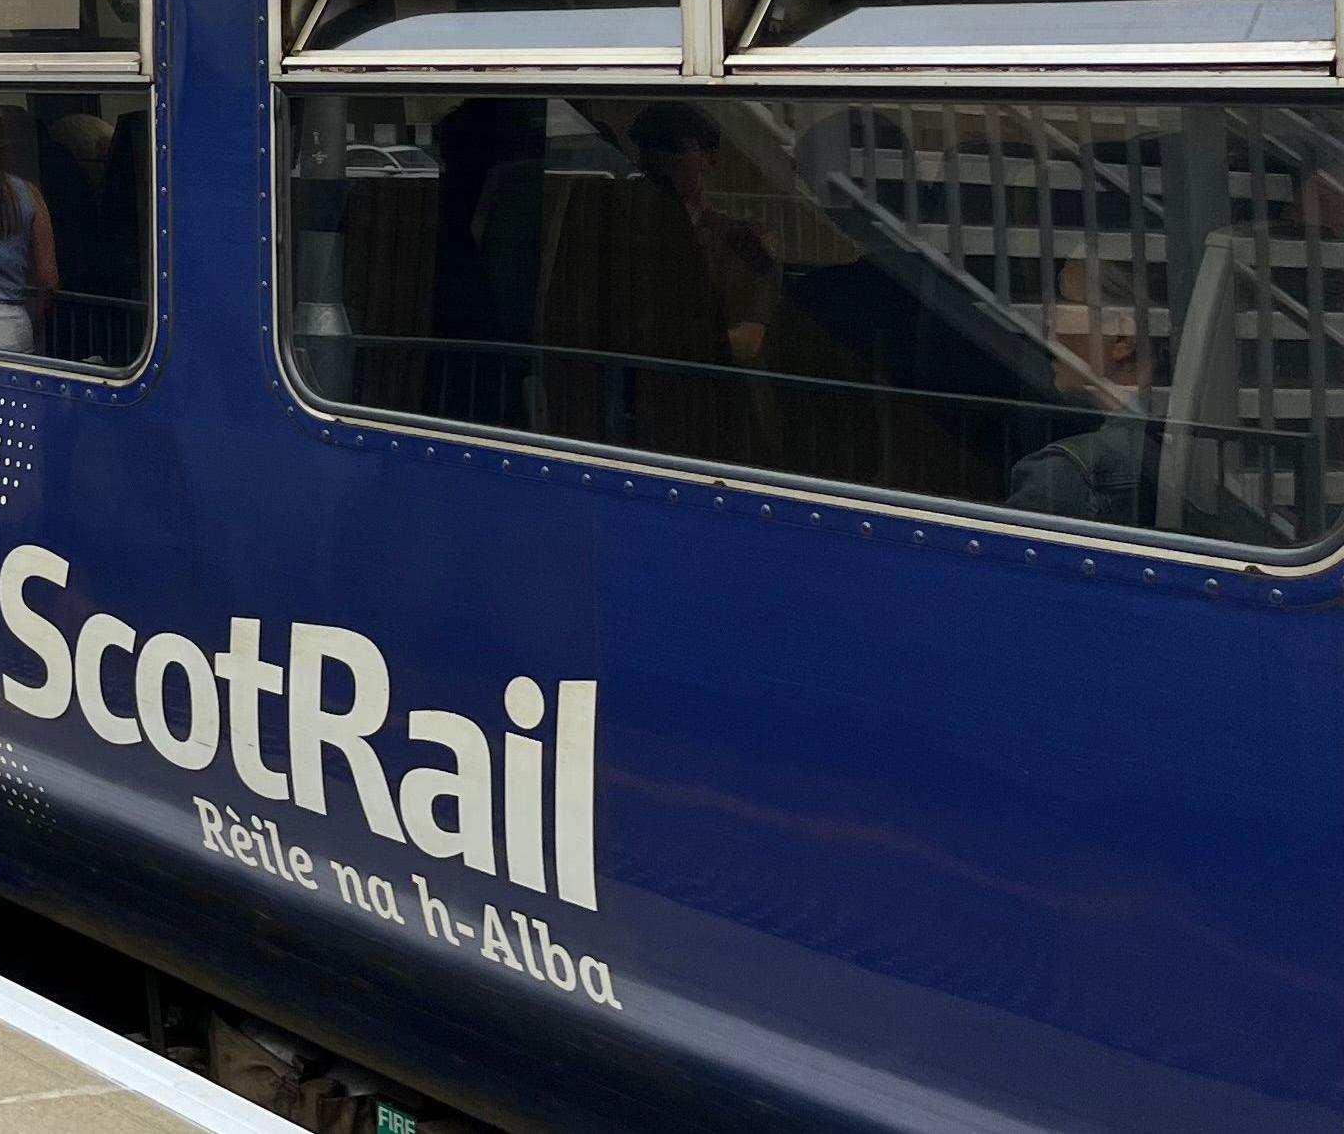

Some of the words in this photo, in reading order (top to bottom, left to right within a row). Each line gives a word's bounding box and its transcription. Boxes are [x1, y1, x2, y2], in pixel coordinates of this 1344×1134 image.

[192, 795, 318, 890] Rèile
[330, 859, 405, 925] na
[411, 873, 623, 1011] h-Alba
[377, 1105, 416, 1134] FIRE
